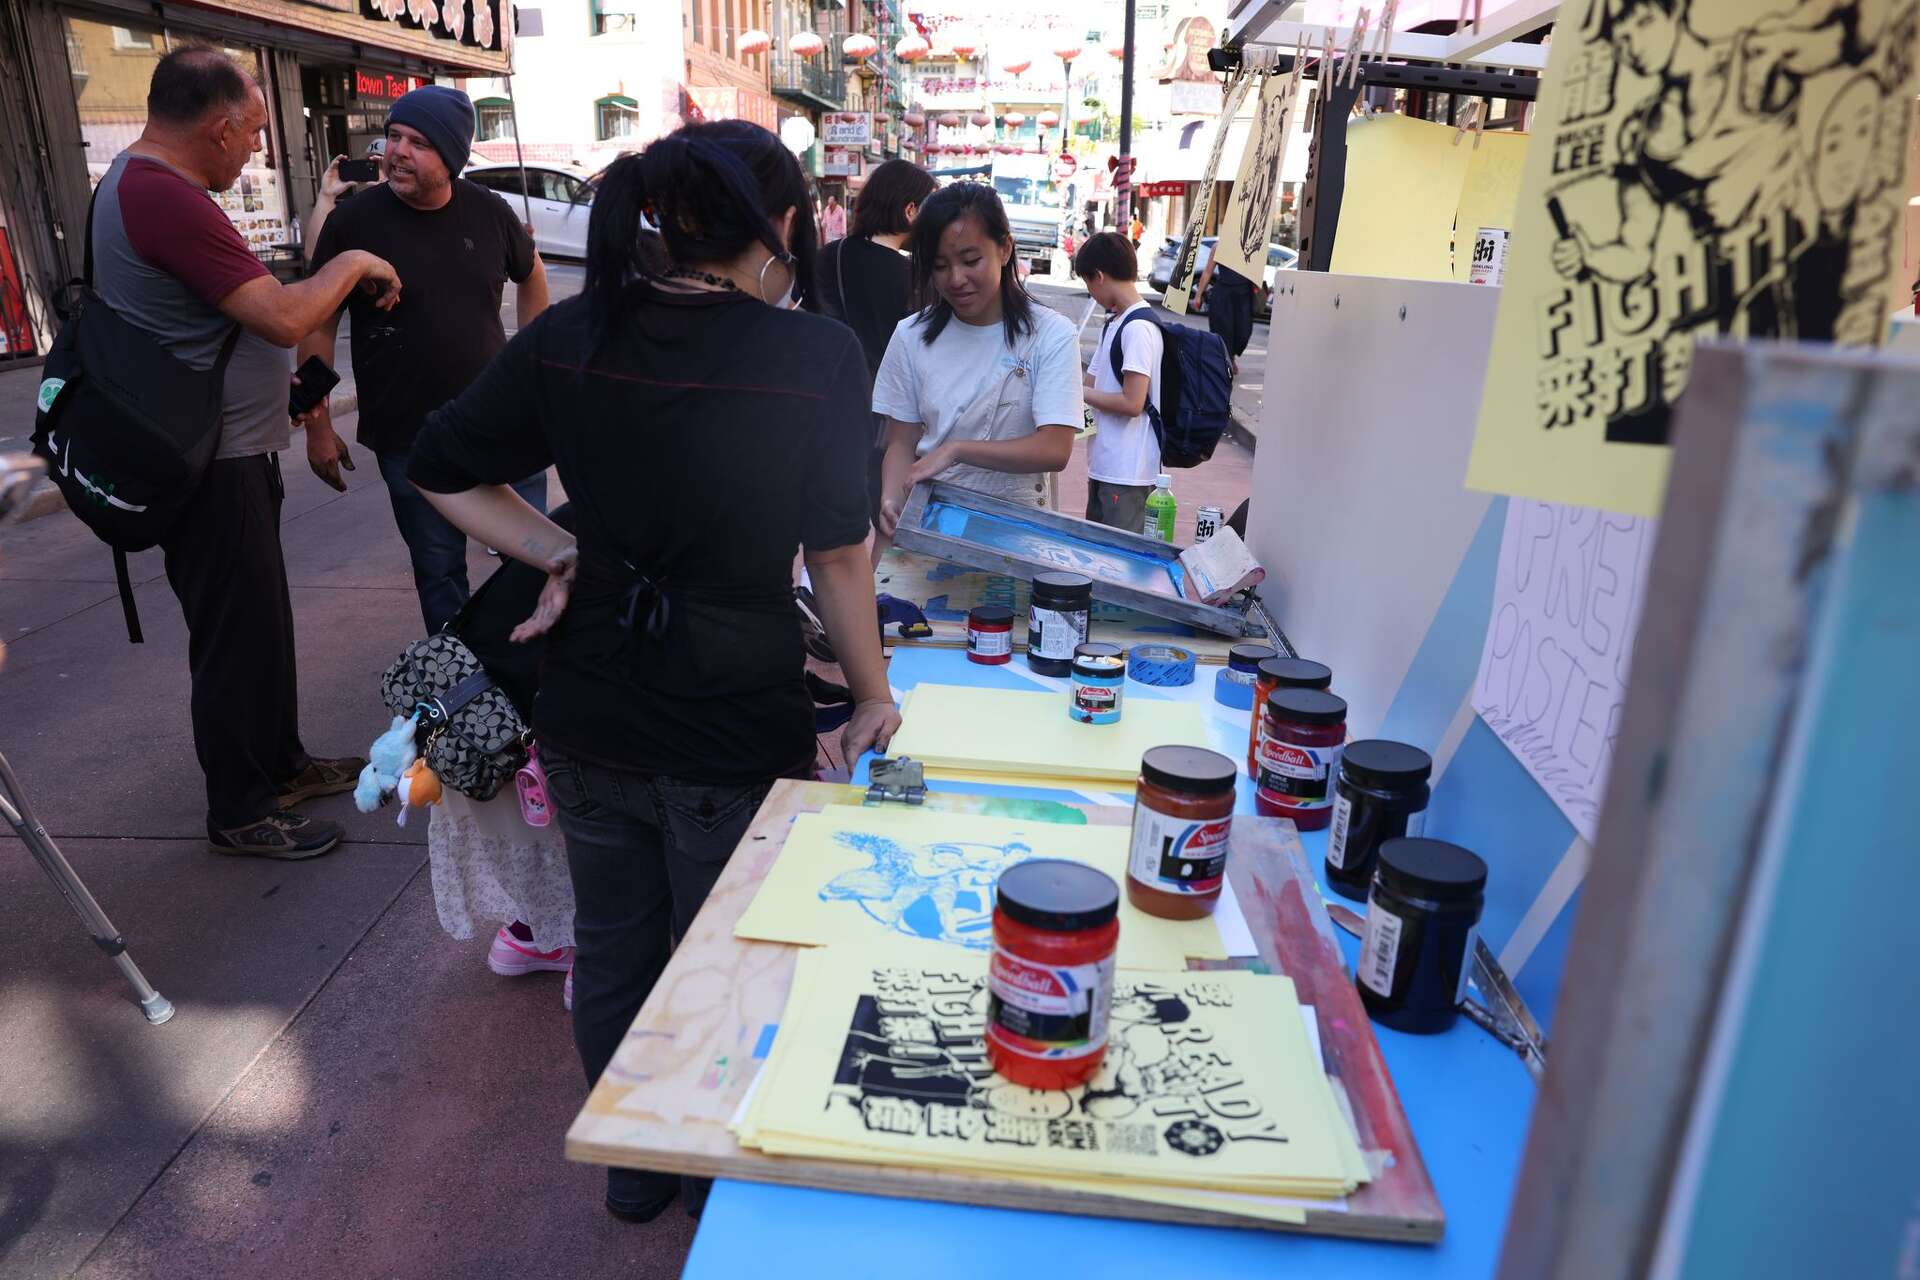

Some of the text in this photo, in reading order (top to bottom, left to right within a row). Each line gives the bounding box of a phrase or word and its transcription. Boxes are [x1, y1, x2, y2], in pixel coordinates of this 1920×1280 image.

[1557, 124, 1606, 147] BRUCE
[1551, 140, 1603, 176] LEE
[1514, 498, 1648, 690] FRE
[1158, 1023, 1290, 1144] READY
[1065, 1119, 1085, 1150] KIM
